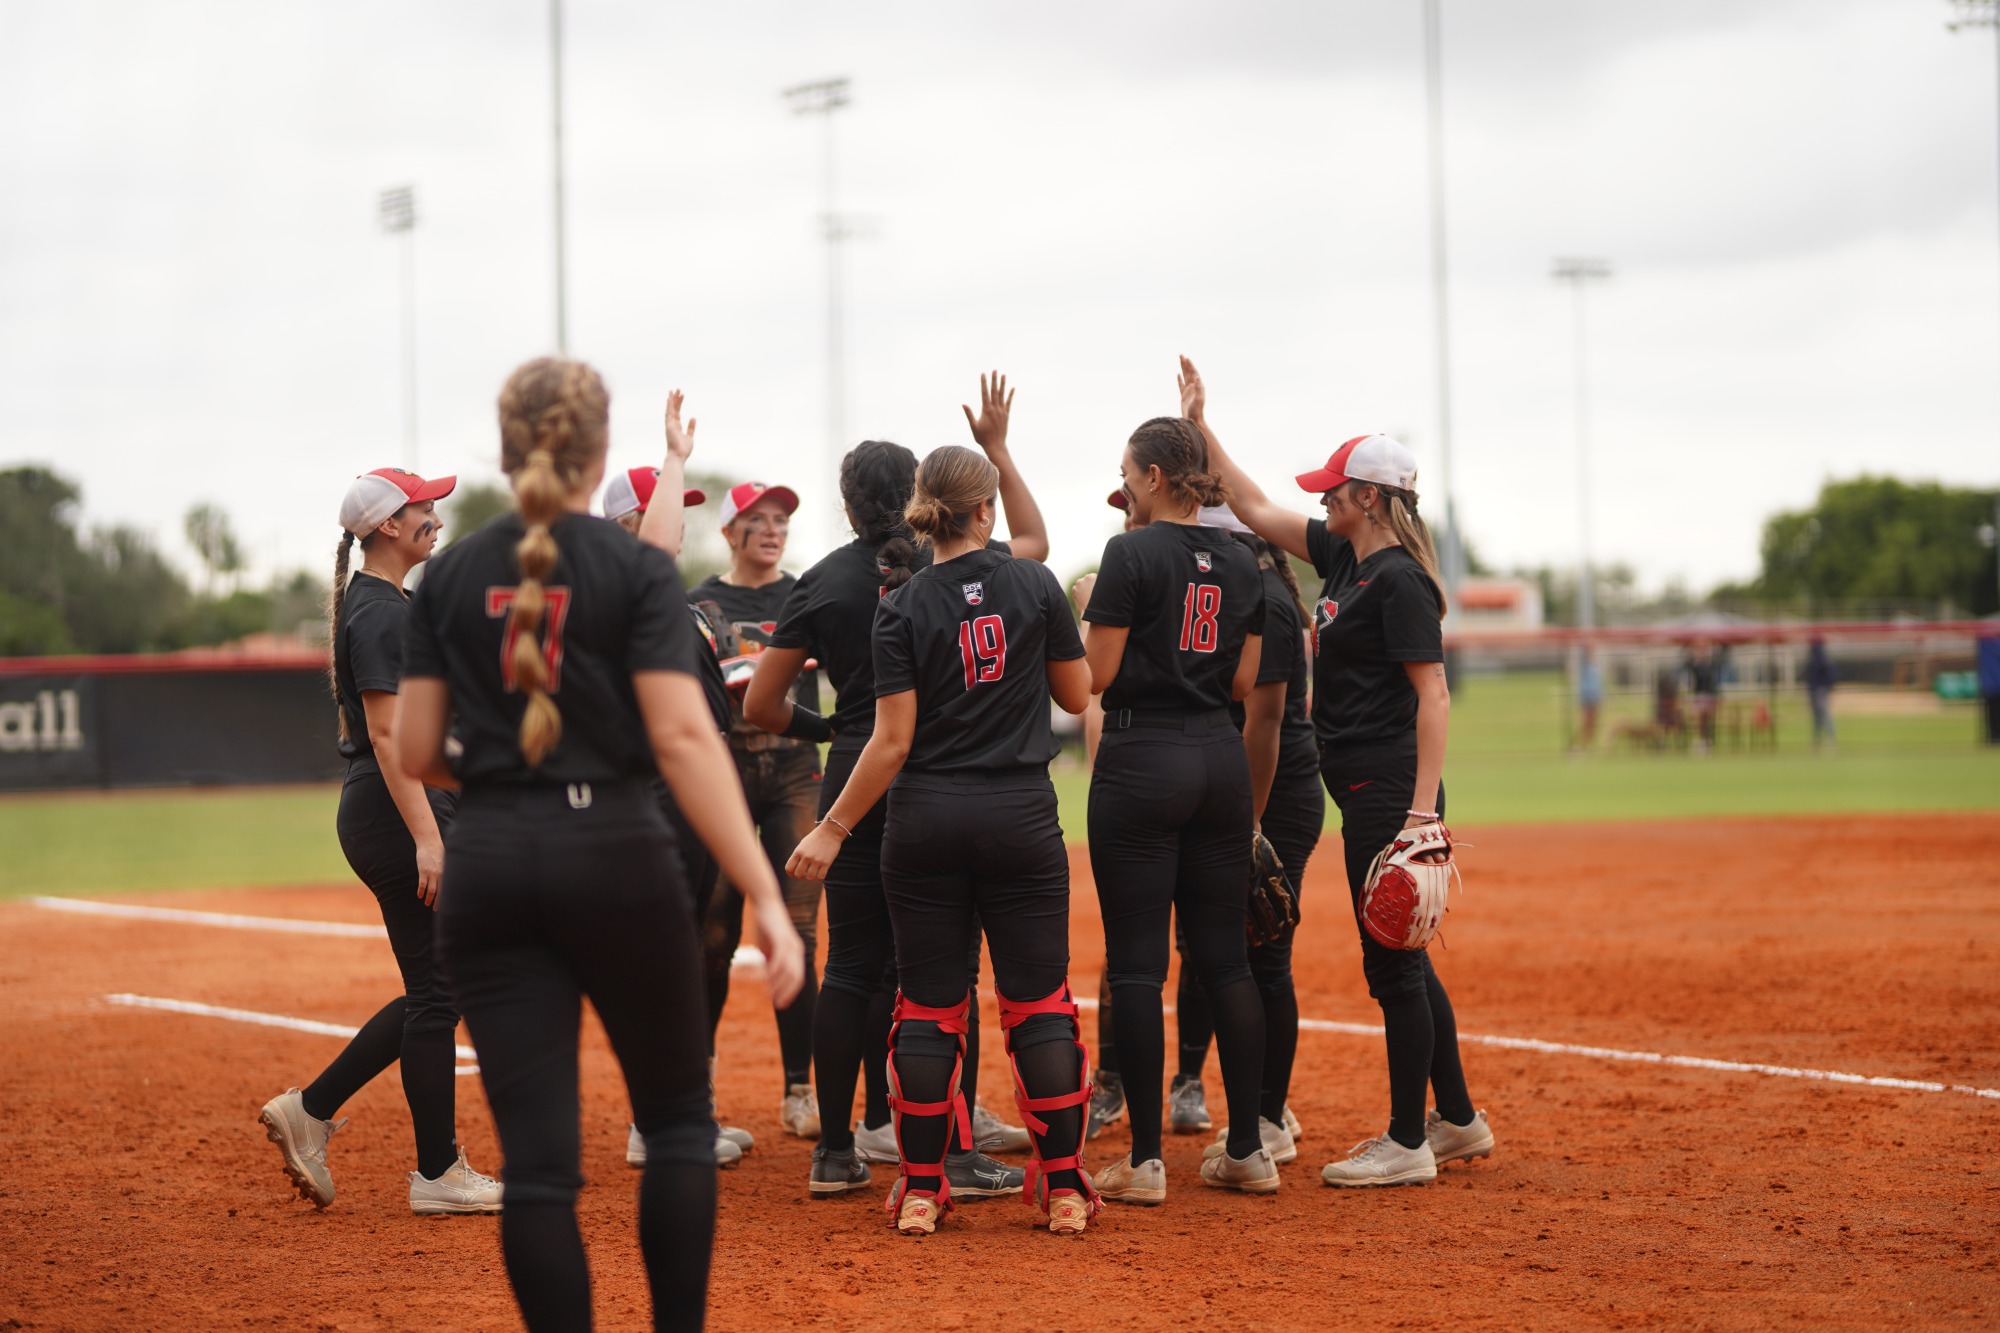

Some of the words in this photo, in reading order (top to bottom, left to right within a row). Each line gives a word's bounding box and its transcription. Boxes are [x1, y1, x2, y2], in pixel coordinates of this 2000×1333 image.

[1180, 582, 1221, 652] 18
[959, 615, 1007, 690] 19
[0, 690, 84, 750] all
